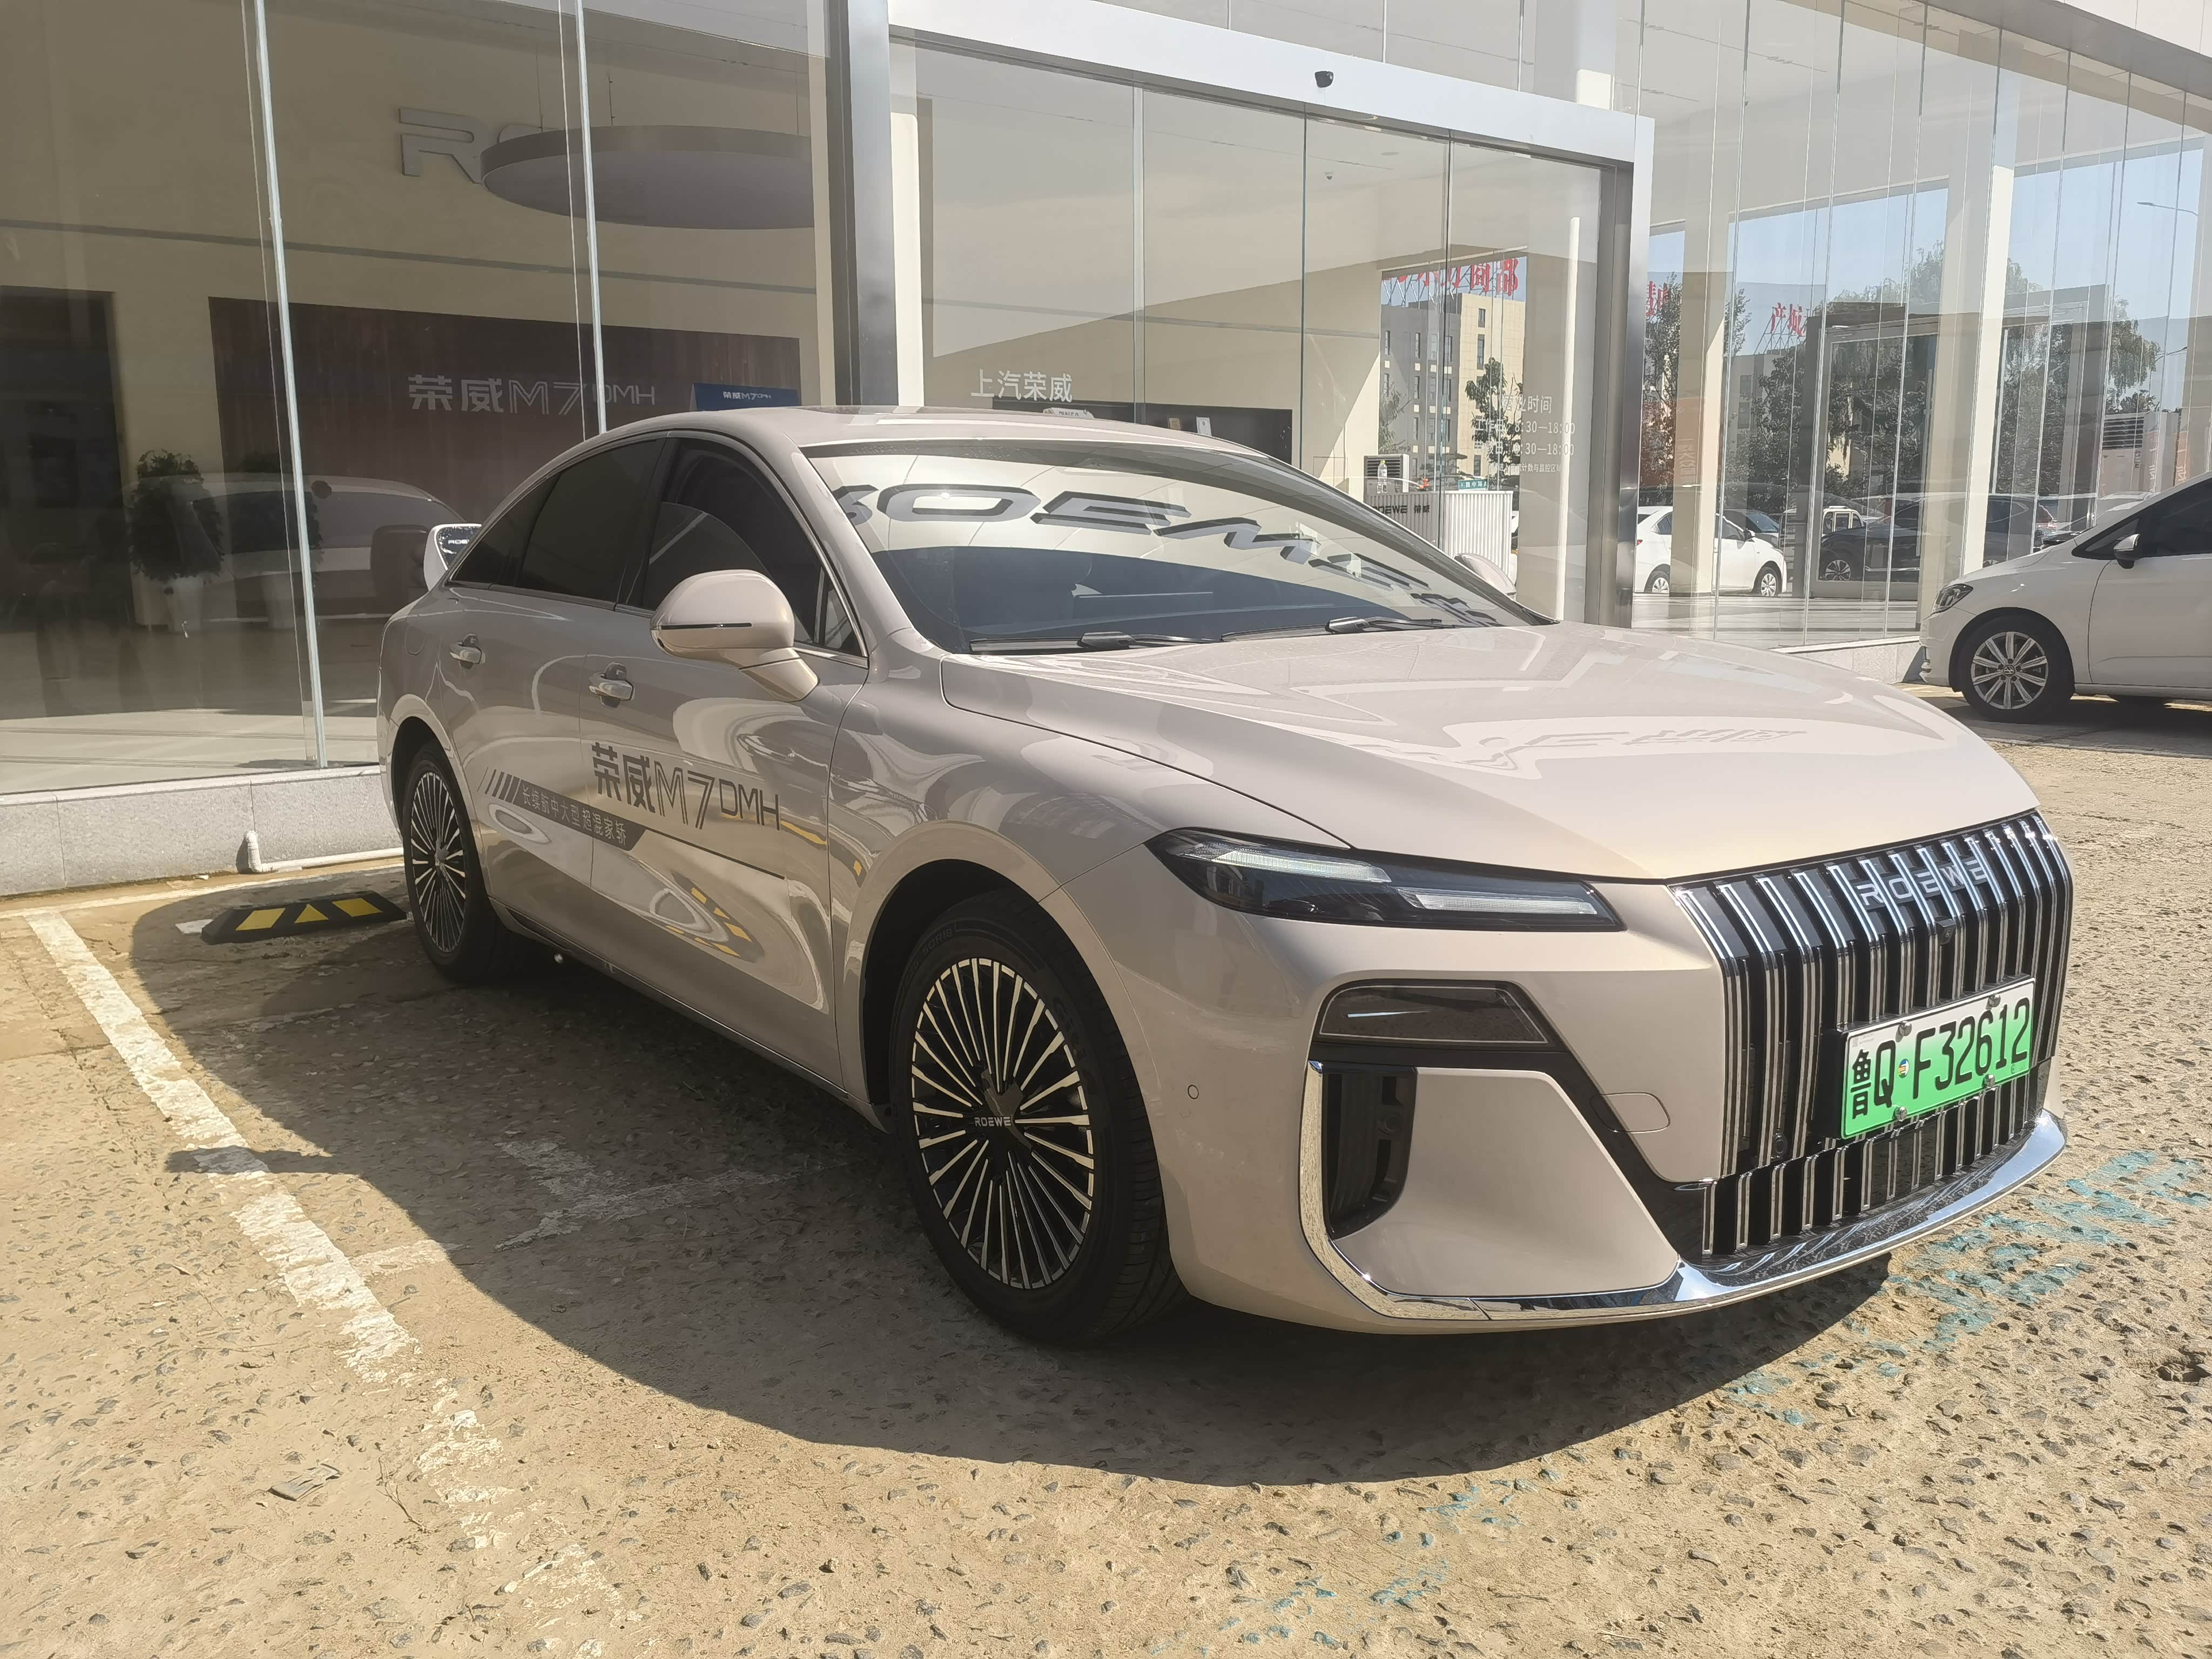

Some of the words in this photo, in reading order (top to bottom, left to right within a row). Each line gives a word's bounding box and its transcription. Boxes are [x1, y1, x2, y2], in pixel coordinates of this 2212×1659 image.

[970, 368, 1073, 403] 上汽荣威
[1856, 859, 1987, 906] ROEWE
[974, 1116, 1011, 1128] ROEWE
